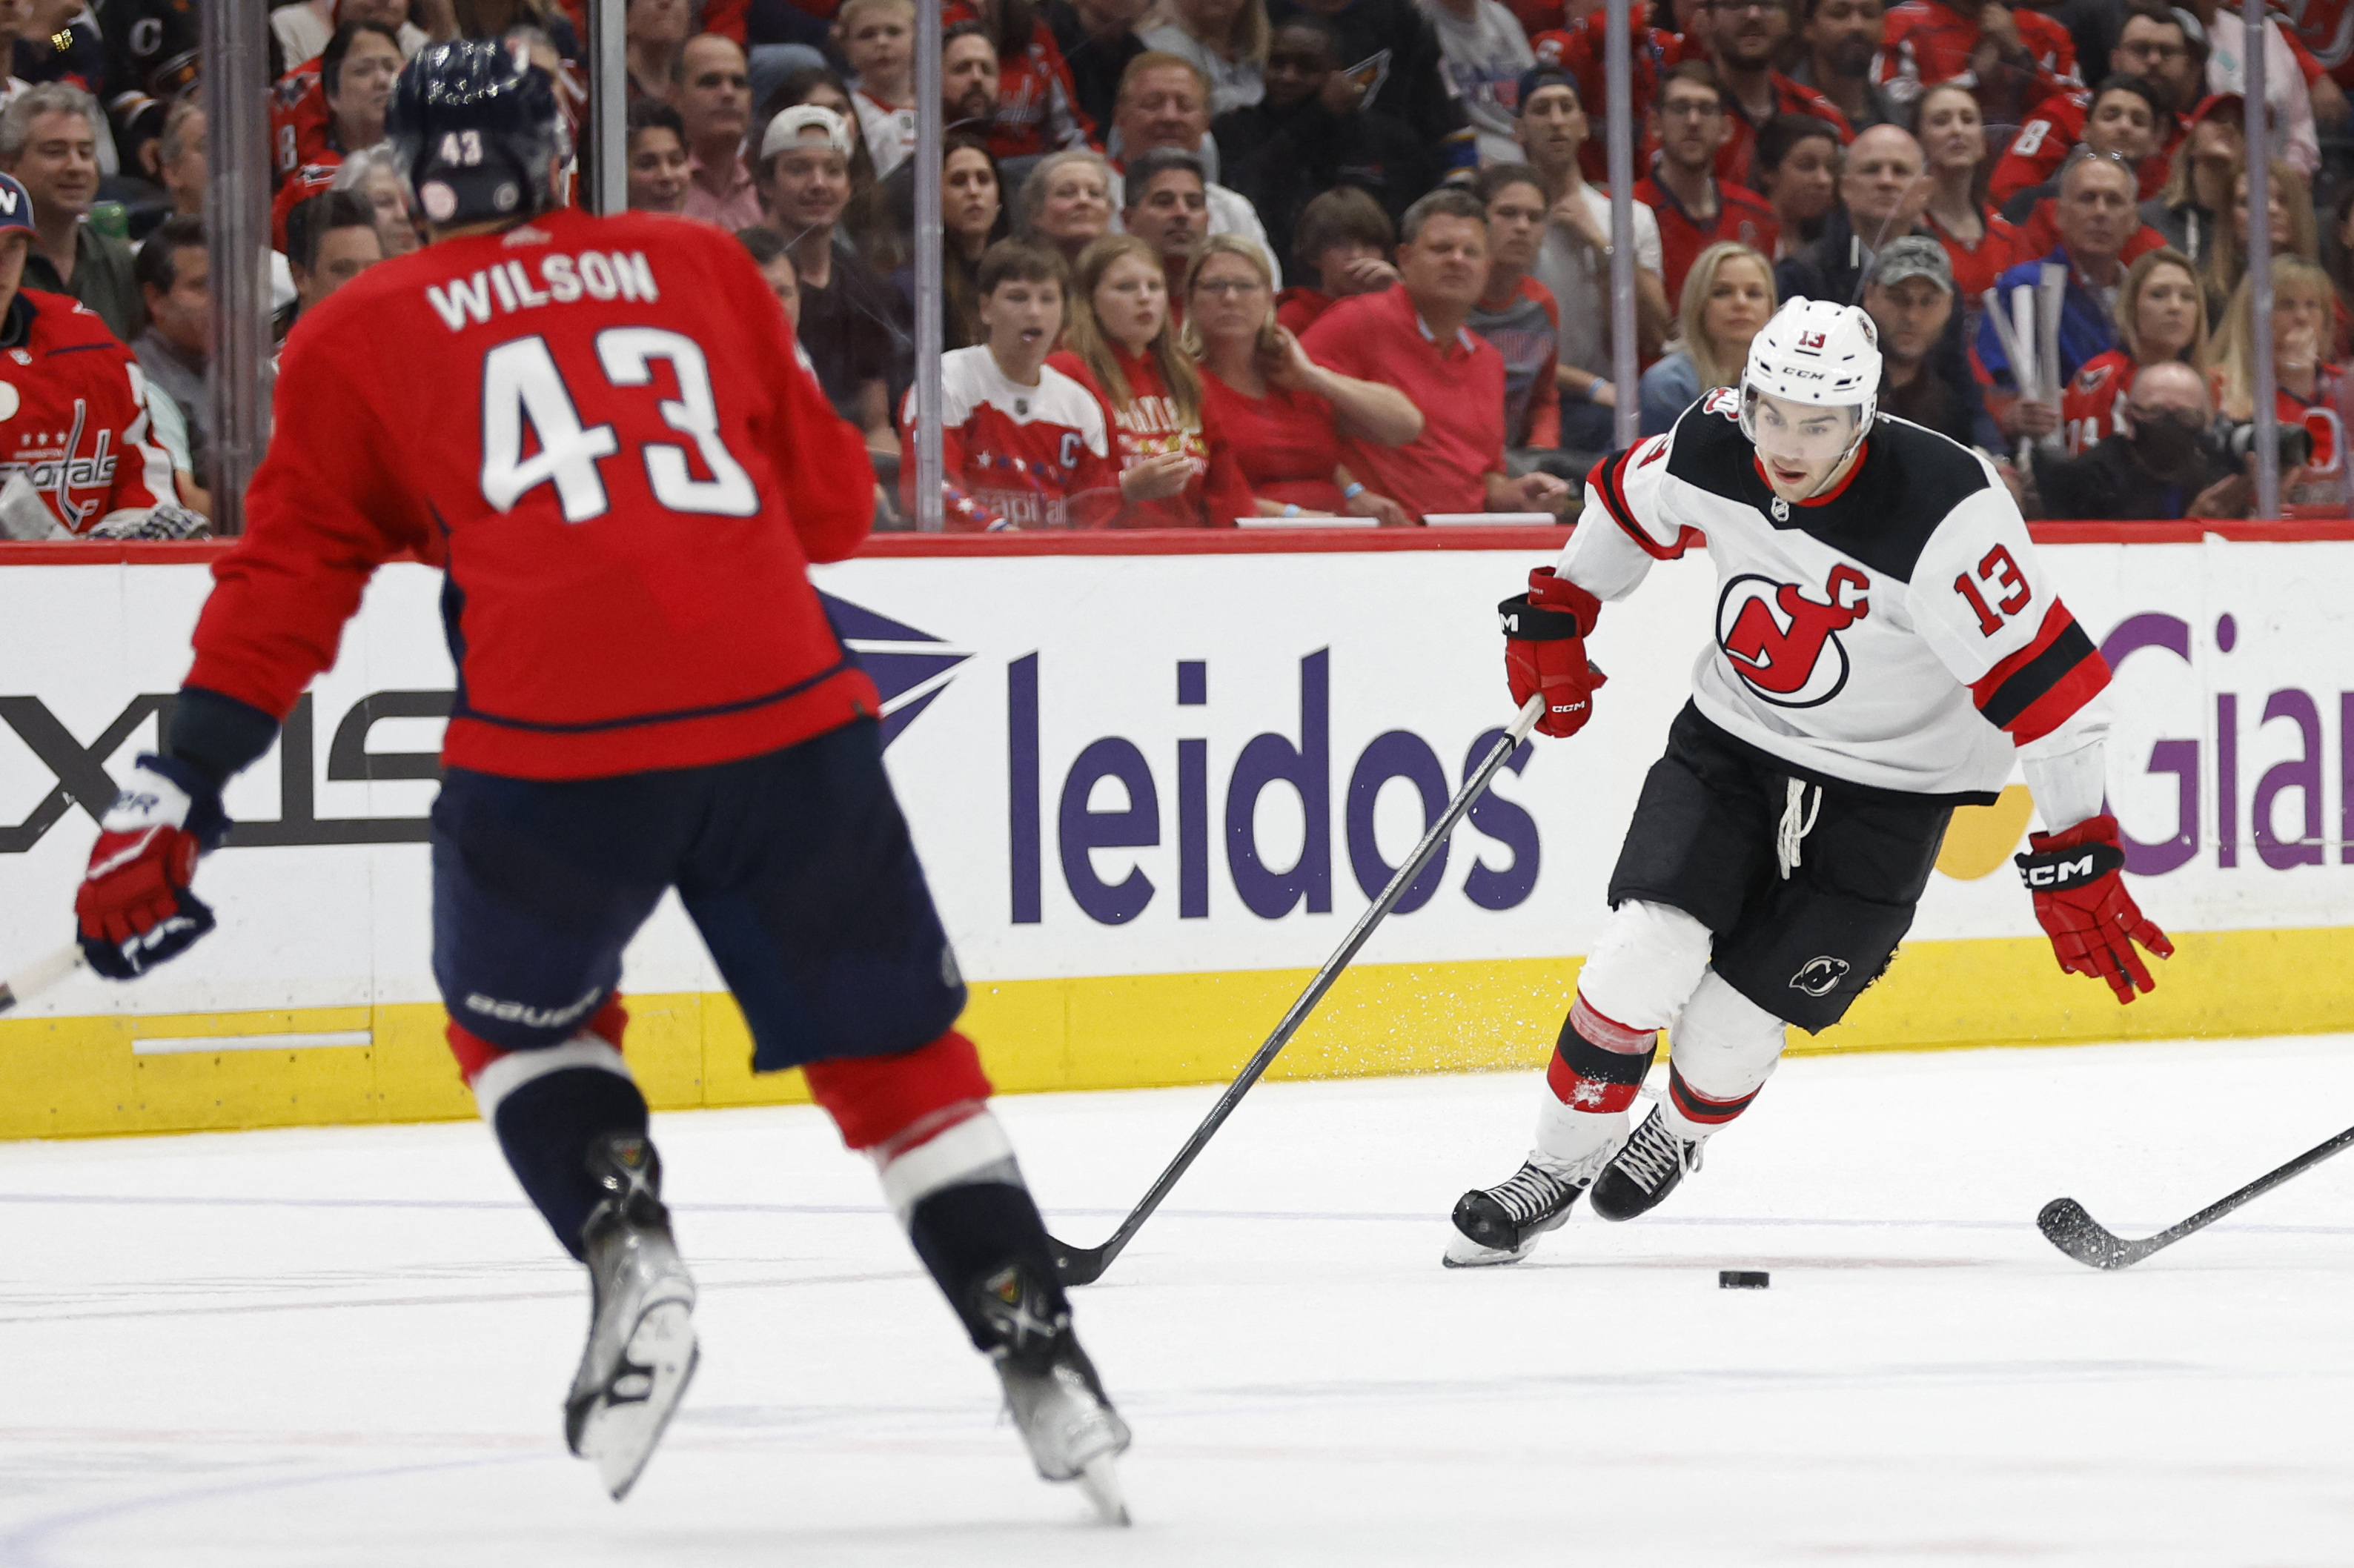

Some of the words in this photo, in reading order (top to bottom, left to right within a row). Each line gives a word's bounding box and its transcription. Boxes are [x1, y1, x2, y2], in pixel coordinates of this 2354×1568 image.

[440, 127, 483, 167] 43
[2012, 119, 2052, 157] 8
[426, 250, 660, 332] WILSON
[1798, 330, 1826, 348] 13
[1783, 367, 1826, 380] CCM
[480, 325, 761, 523] 43
[1058, 431, 1082, 468] C
[1826, 562, 1871, 619] C
[1954, 543, 2032, 637] 13
[1552, 700, 1585, 713] CCM
[2100, 609, 2354, 877] Gia
[1008, 645, 1541, 926] leidos
